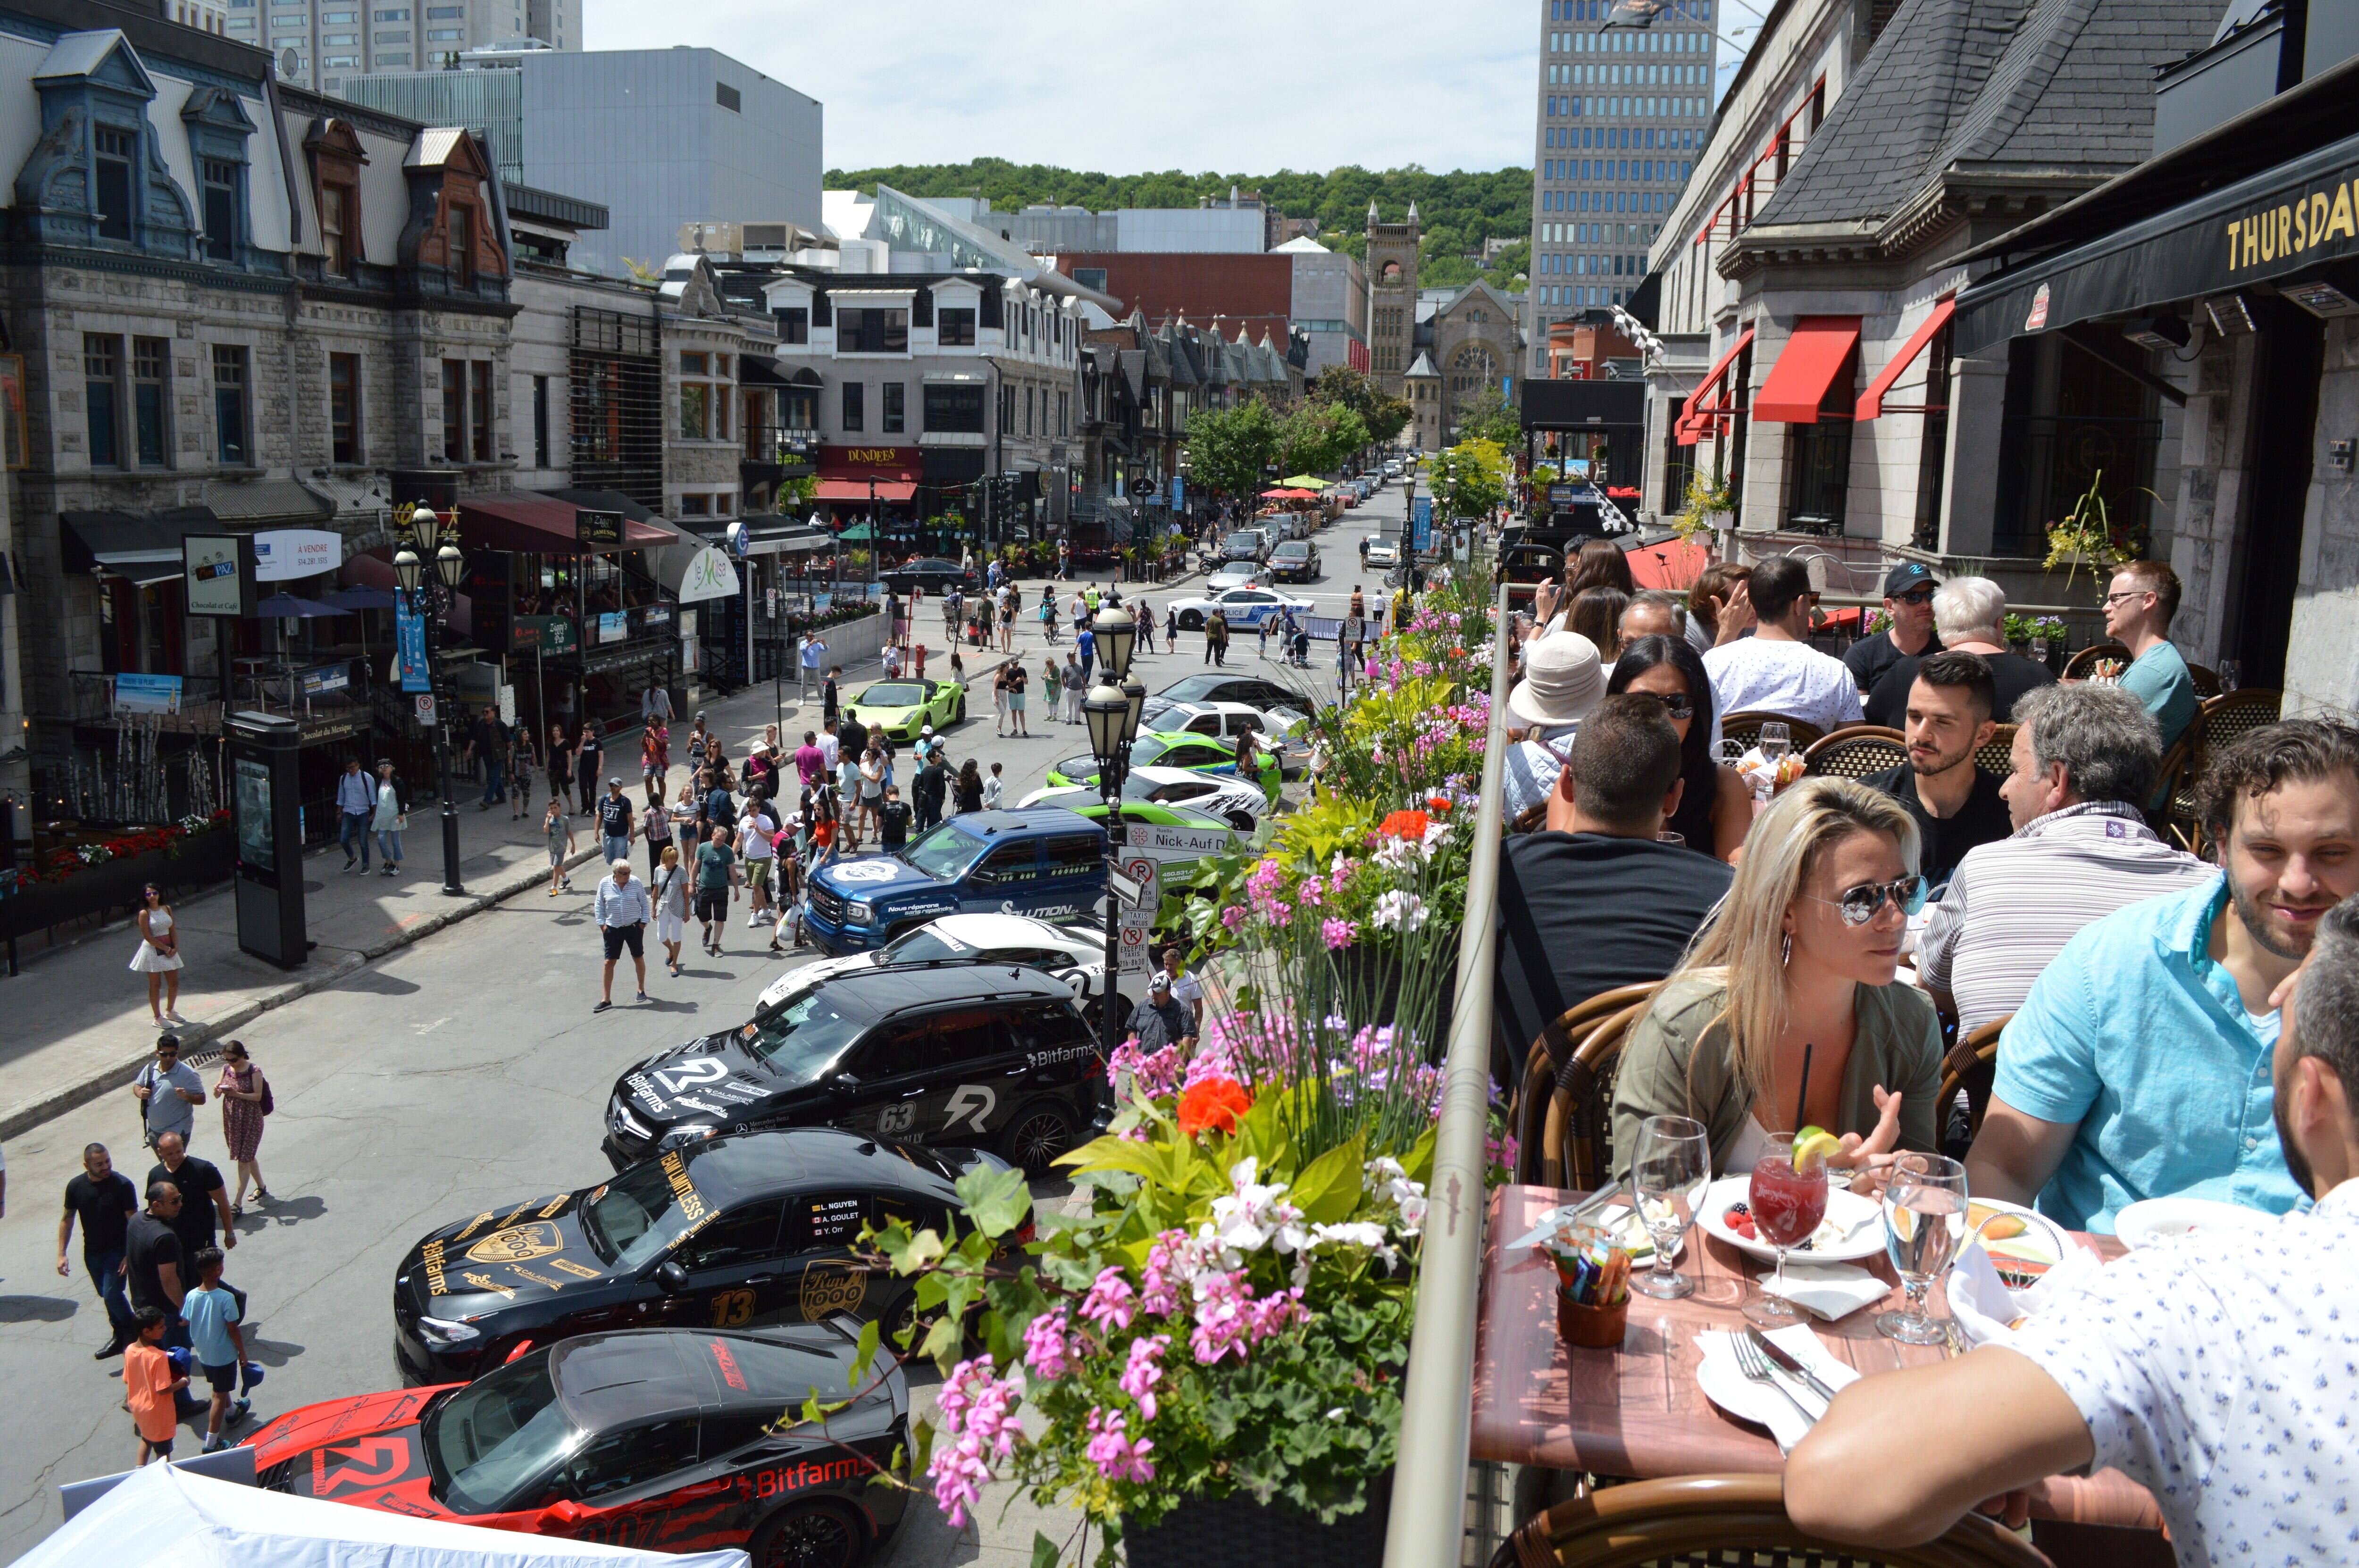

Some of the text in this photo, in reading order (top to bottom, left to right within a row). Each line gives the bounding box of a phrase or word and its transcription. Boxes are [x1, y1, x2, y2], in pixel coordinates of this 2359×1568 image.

[848, 449, 895, 462] DUNDEES
[593, 529, 617, 537] JAMESON
[298, 543, 327, 553] À VENDRE
[695, 562, 701, 581] le
[191, 601, 217, 609] Chocolat
[225, 601, 238, 610] Café
[554, 635, 564, 644] Pub
[736, 618, 745, 678] ELECTRIC
[324, 727, 330, 736] du
[331, 724, 352, 736] Mexique
[1156, 834, 1212, 849] Nick-Auf
[908, 902, 939, 912] réparons
[921, 905, 954, 915] repeindre
[1121, 944, 1145, 953] EXCEPTE
[1037, 1044, 1095, 1067] Bitfarms
[627, 1075, 668, 1113] Bitfarms
[713, 1090, 755, 1103] CALABOGIE
[749, 1115, 790, 1127] Mercedes-Benz
[877, 1101, 916, 1134] 63
[661, 1151, 704, 1221] TEAM LIMITLESS
[828, 1200, 858, 1209] NGUYEN
[831, 1212, 859, 1221] GOULET
[666, 1210, 721, 1251] TEAM LIMITLESS
[423, 1245, 448, 1296] Bitfarms
[522, 1269, 564, 1288] CALABOGIE
[805, 1271, 845, 1290] Run
[805, 1286, 862, 1308] 1000
[711, 1288, 756, 1327] 13
[757, 1455, 876, 1500] Bitfarms
